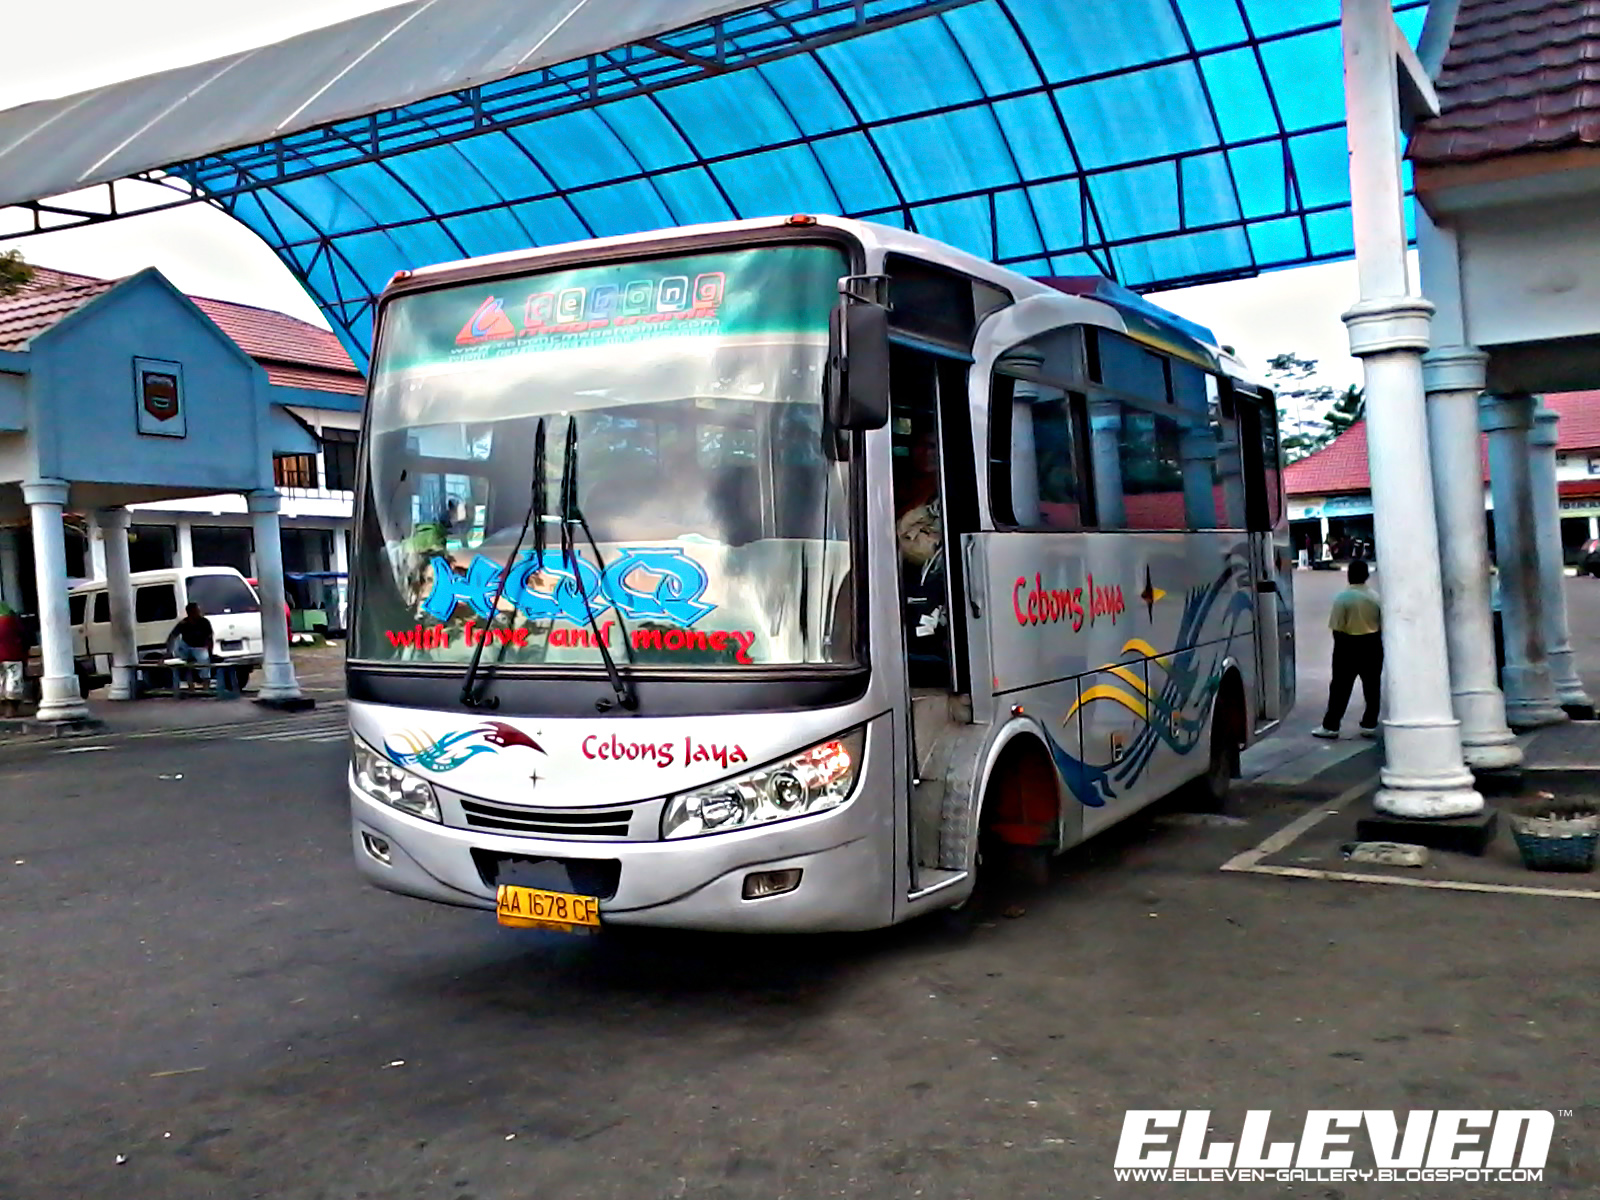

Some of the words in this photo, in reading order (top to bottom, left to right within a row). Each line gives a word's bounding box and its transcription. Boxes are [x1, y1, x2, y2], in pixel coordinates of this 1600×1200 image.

[1013, 572, 1084, 632] Cebong
[385, 623, 449, 650] with
[463, 620, 529, 649] love
[547, 620, 616, 649] and
[631, 629, 755, 665] money
[581, 734, 674, 768] Cebong
[684, 736, 748, 768] Jaya
[499, 889, 521, 913] AA
[528, 892, 568, 918] 1678
